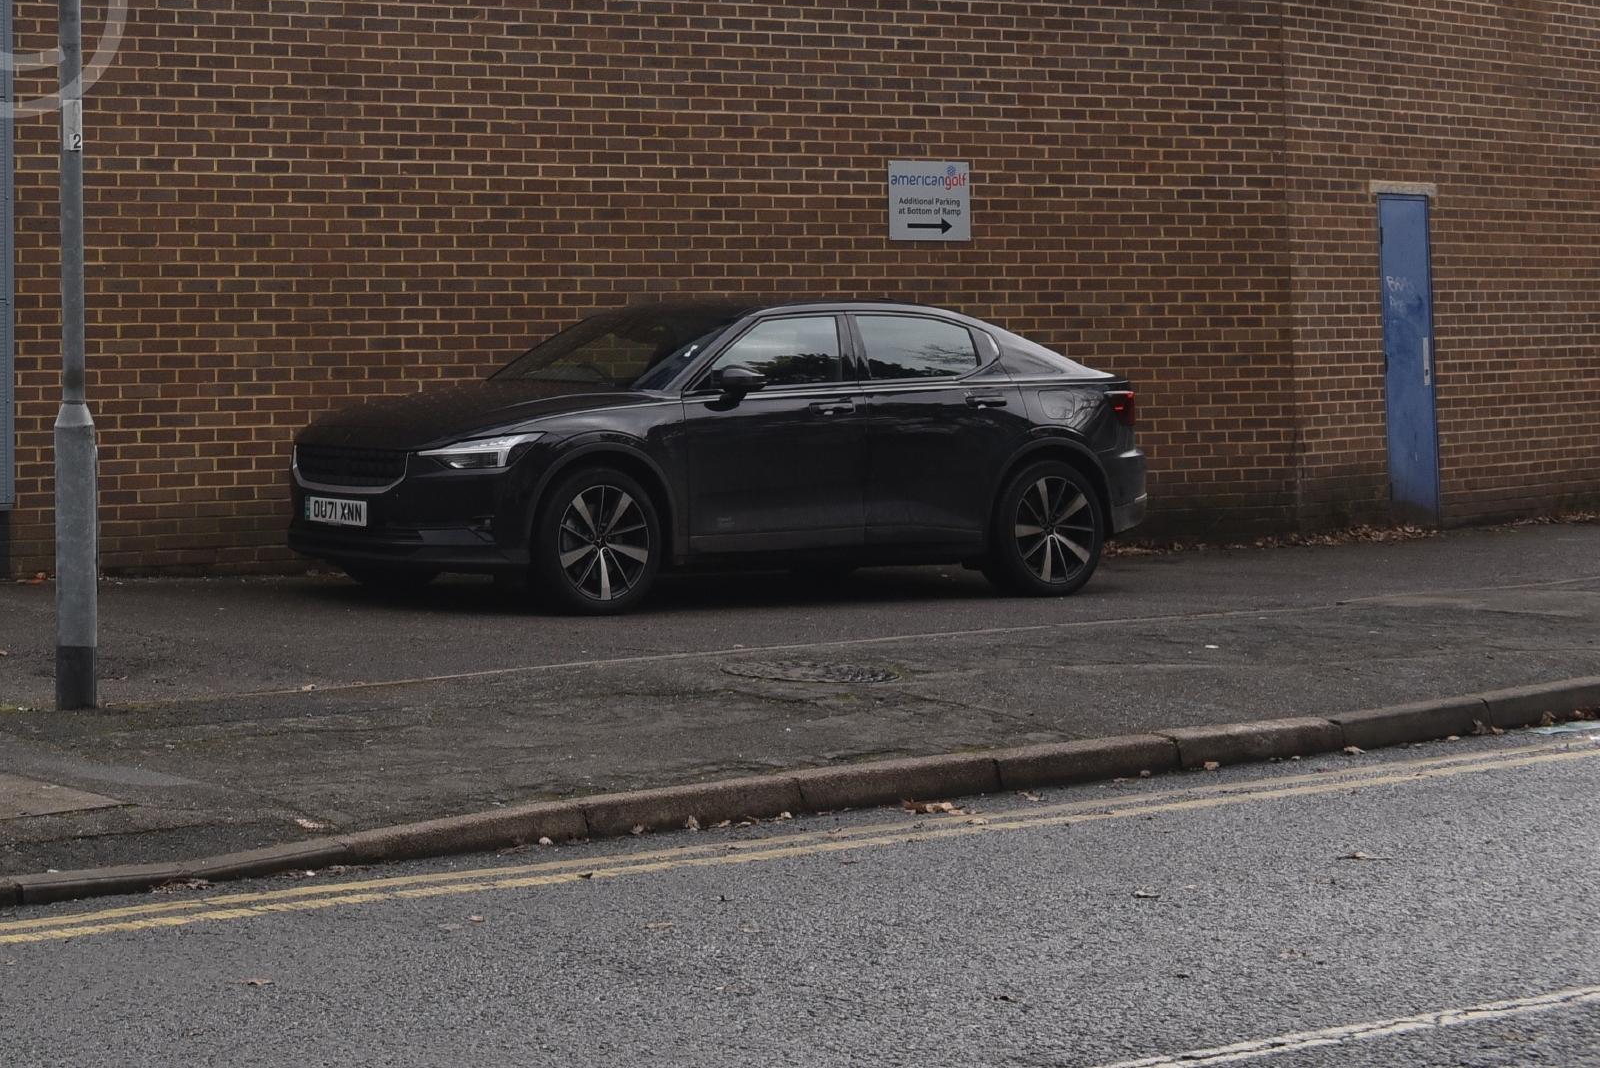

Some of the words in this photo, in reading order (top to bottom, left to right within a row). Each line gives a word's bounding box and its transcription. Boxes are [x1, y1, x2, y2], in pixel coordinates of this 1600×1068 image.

[891, 173, 967, 190] americangolf
[899, 197, 934, 205] Additional
[935, 198, 960, 207] Parking
[898, 207, 905, 215] at
[907, 207, 932, 215] Bottom
[934, 207, 941, 215] of
[942, 208, 961, 216] Ramp
[340, 502, 362, 522] XNN
